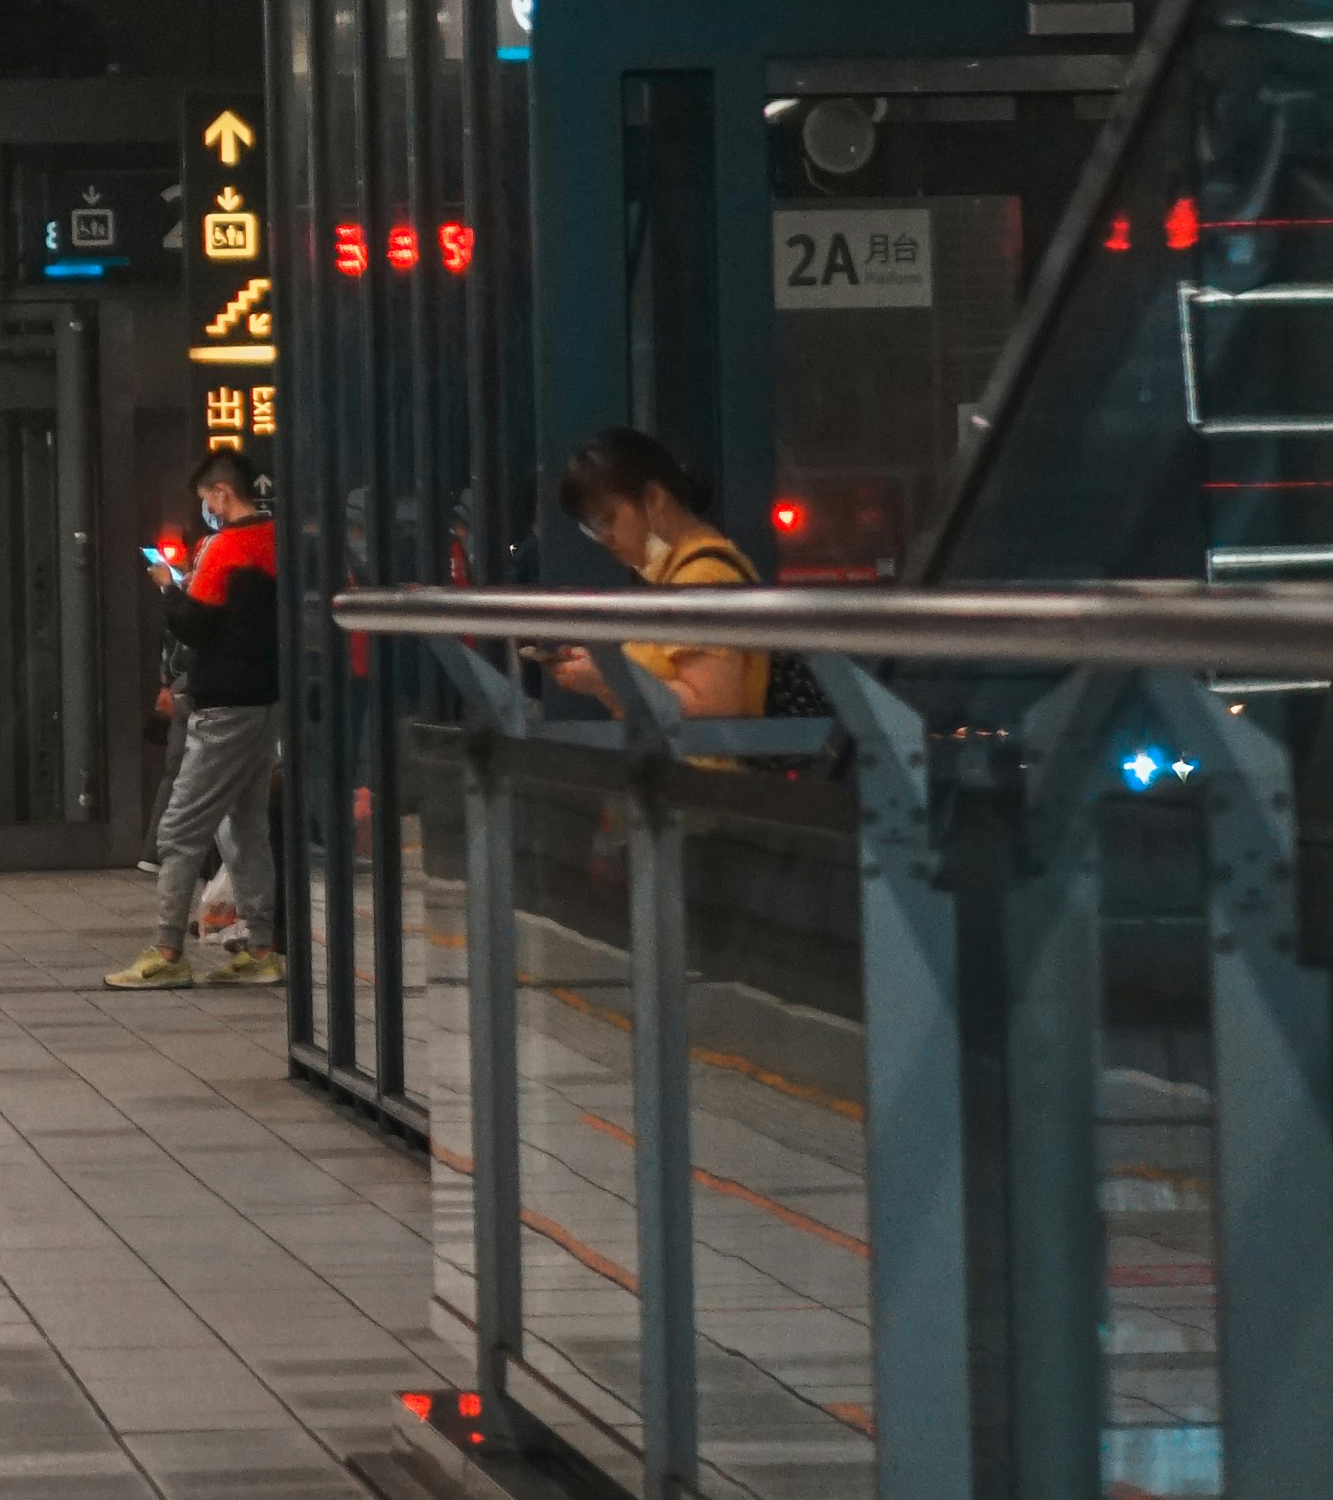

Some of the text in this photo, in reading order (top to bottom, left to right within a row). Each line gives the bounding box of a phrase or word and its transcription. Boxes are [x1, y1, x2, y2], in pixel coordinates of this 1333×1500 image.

[786, 233, 918, 287] 2A 月台
[252, 386, 276, 436] Exit
